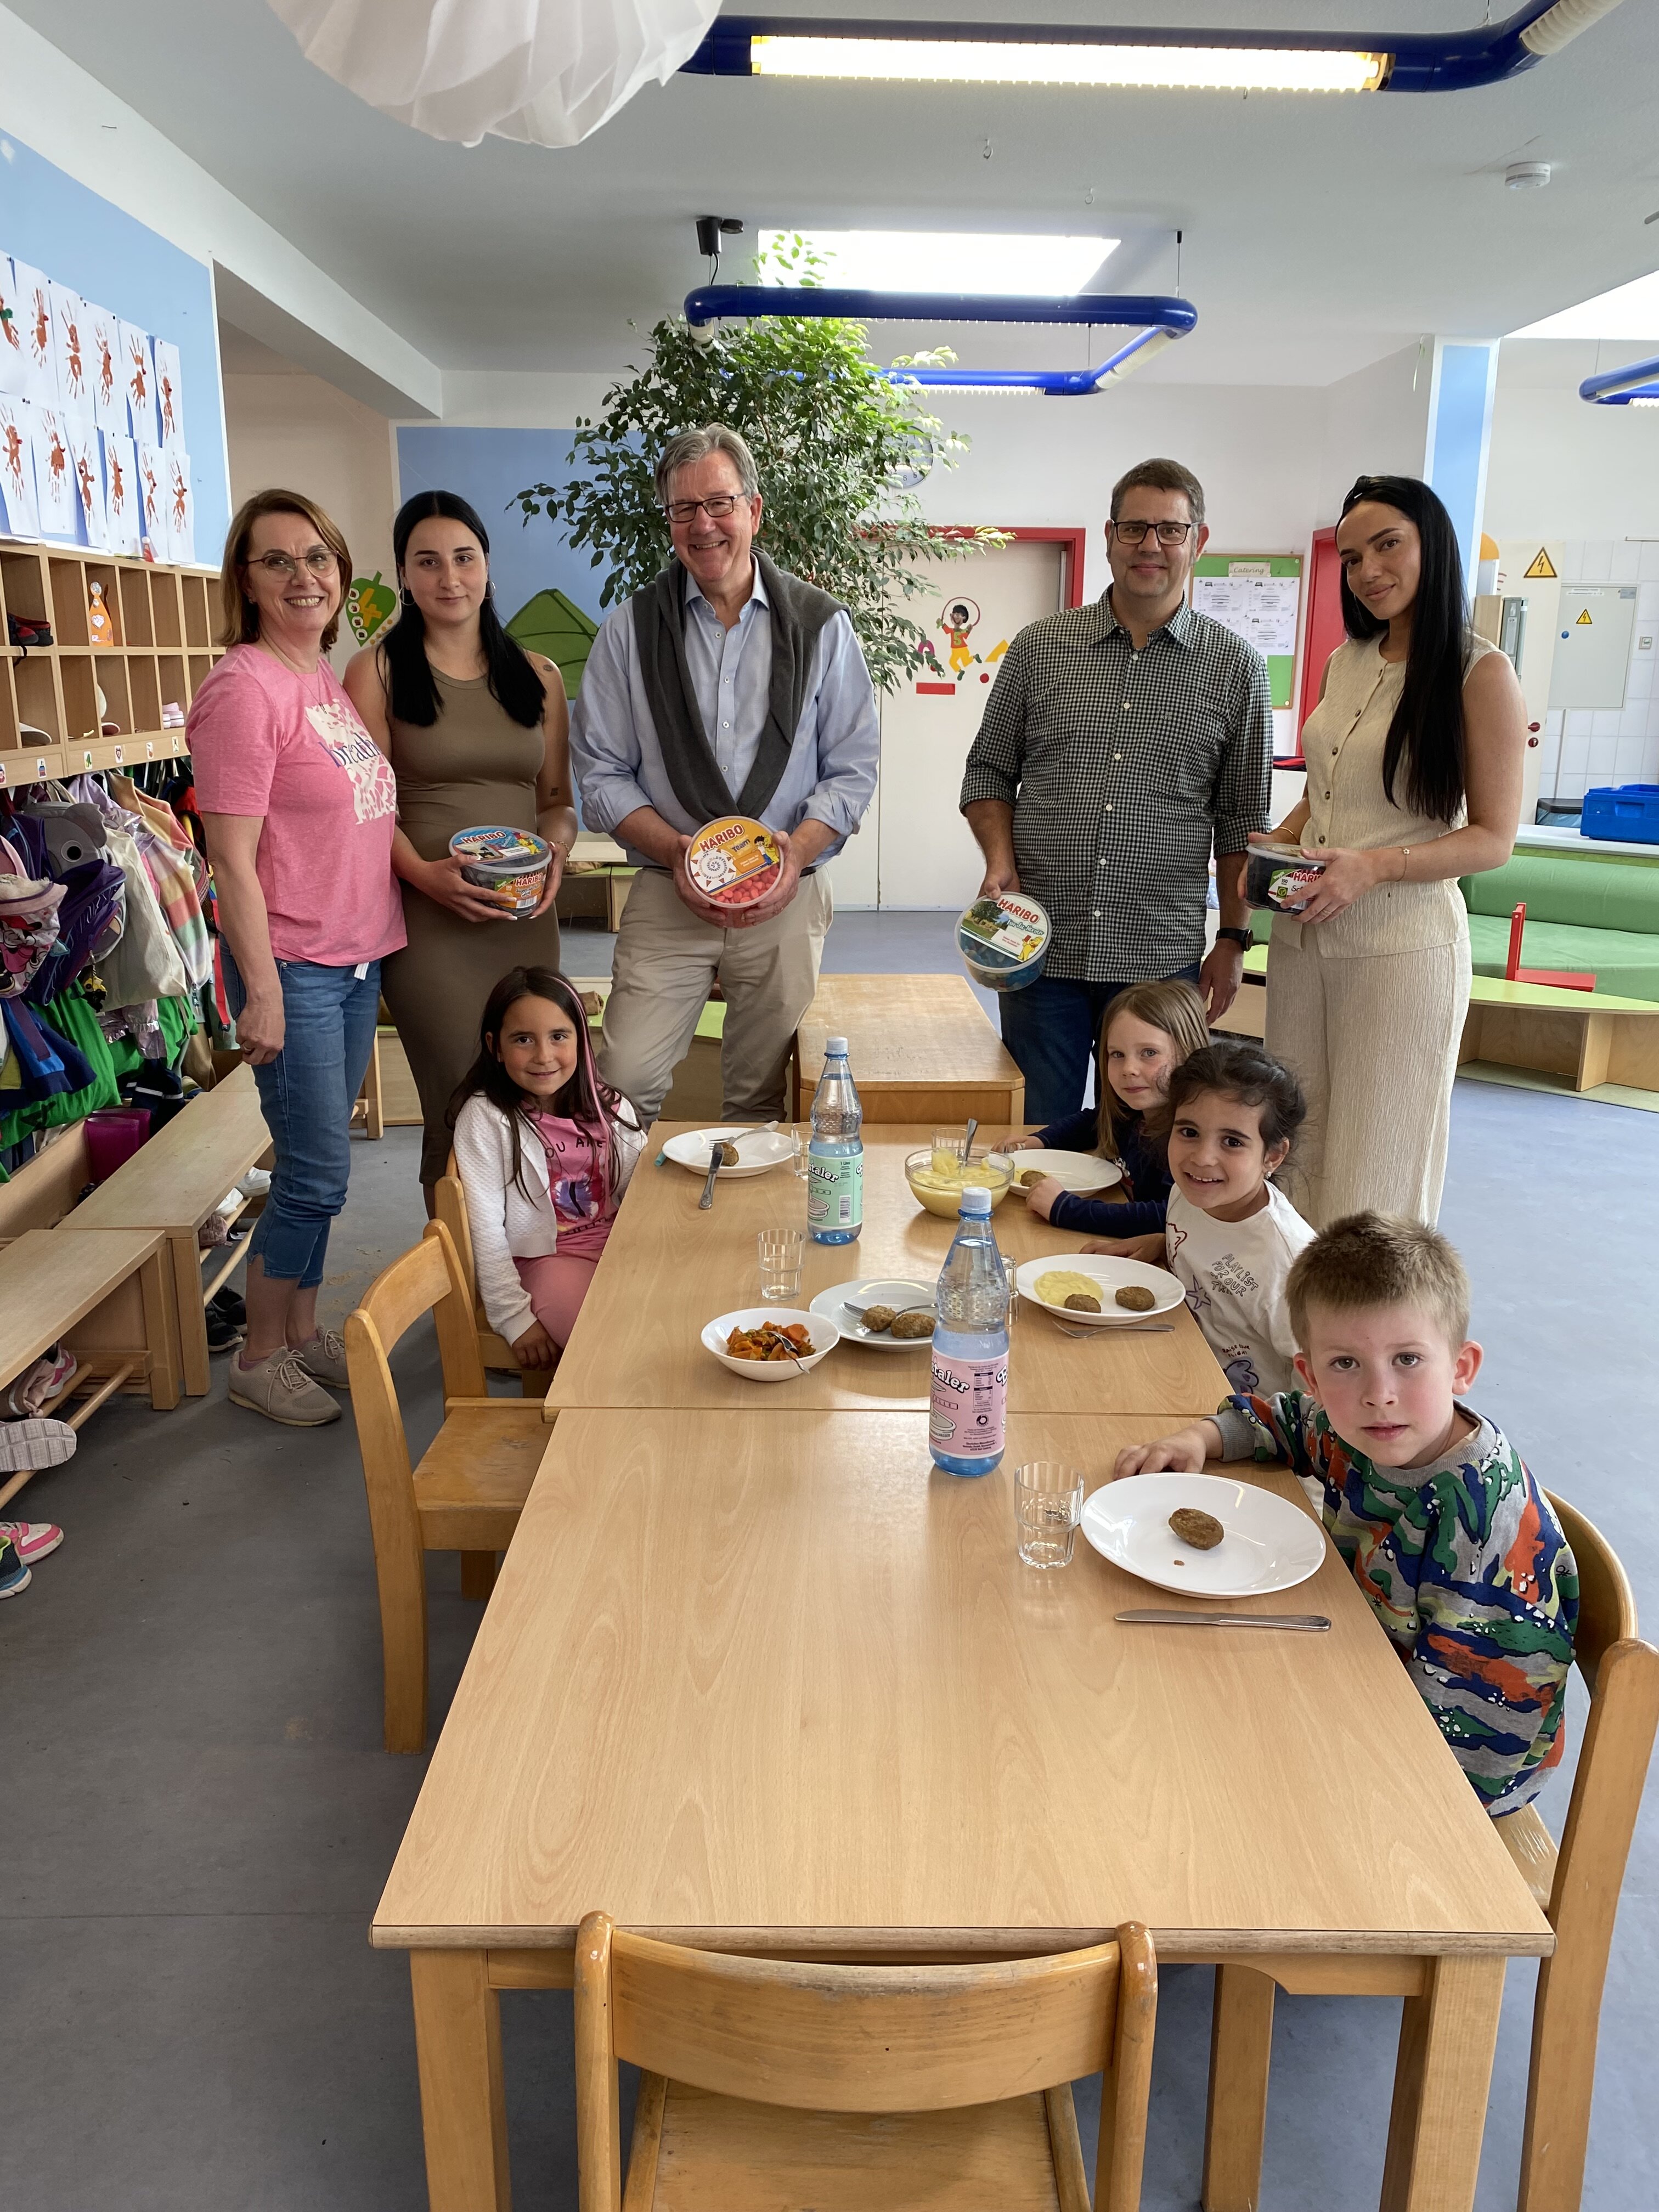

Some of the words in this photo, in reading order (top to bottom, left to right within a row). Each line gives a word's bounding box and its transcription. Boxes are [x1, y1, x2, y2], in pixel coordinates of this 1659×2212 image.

[1233, 566, 1265, 575] Catering
[953, 631, 962, 646] 5
[461, 831, 506, 844] HARIBO
[698, 824, 744, 852] HARIBO
[515, 872, 543, 887] HARIBO
[997, 899, 1040, 924] HARIBO
[545, 1141, 566, 1159] OU
[808, 1163, 839, 1182] staler
[1211, 1261, 1229, 1279] FOR
[1224, 1277, 1246, 1297] OUR
[931, 1361, 970, 1393] staler
